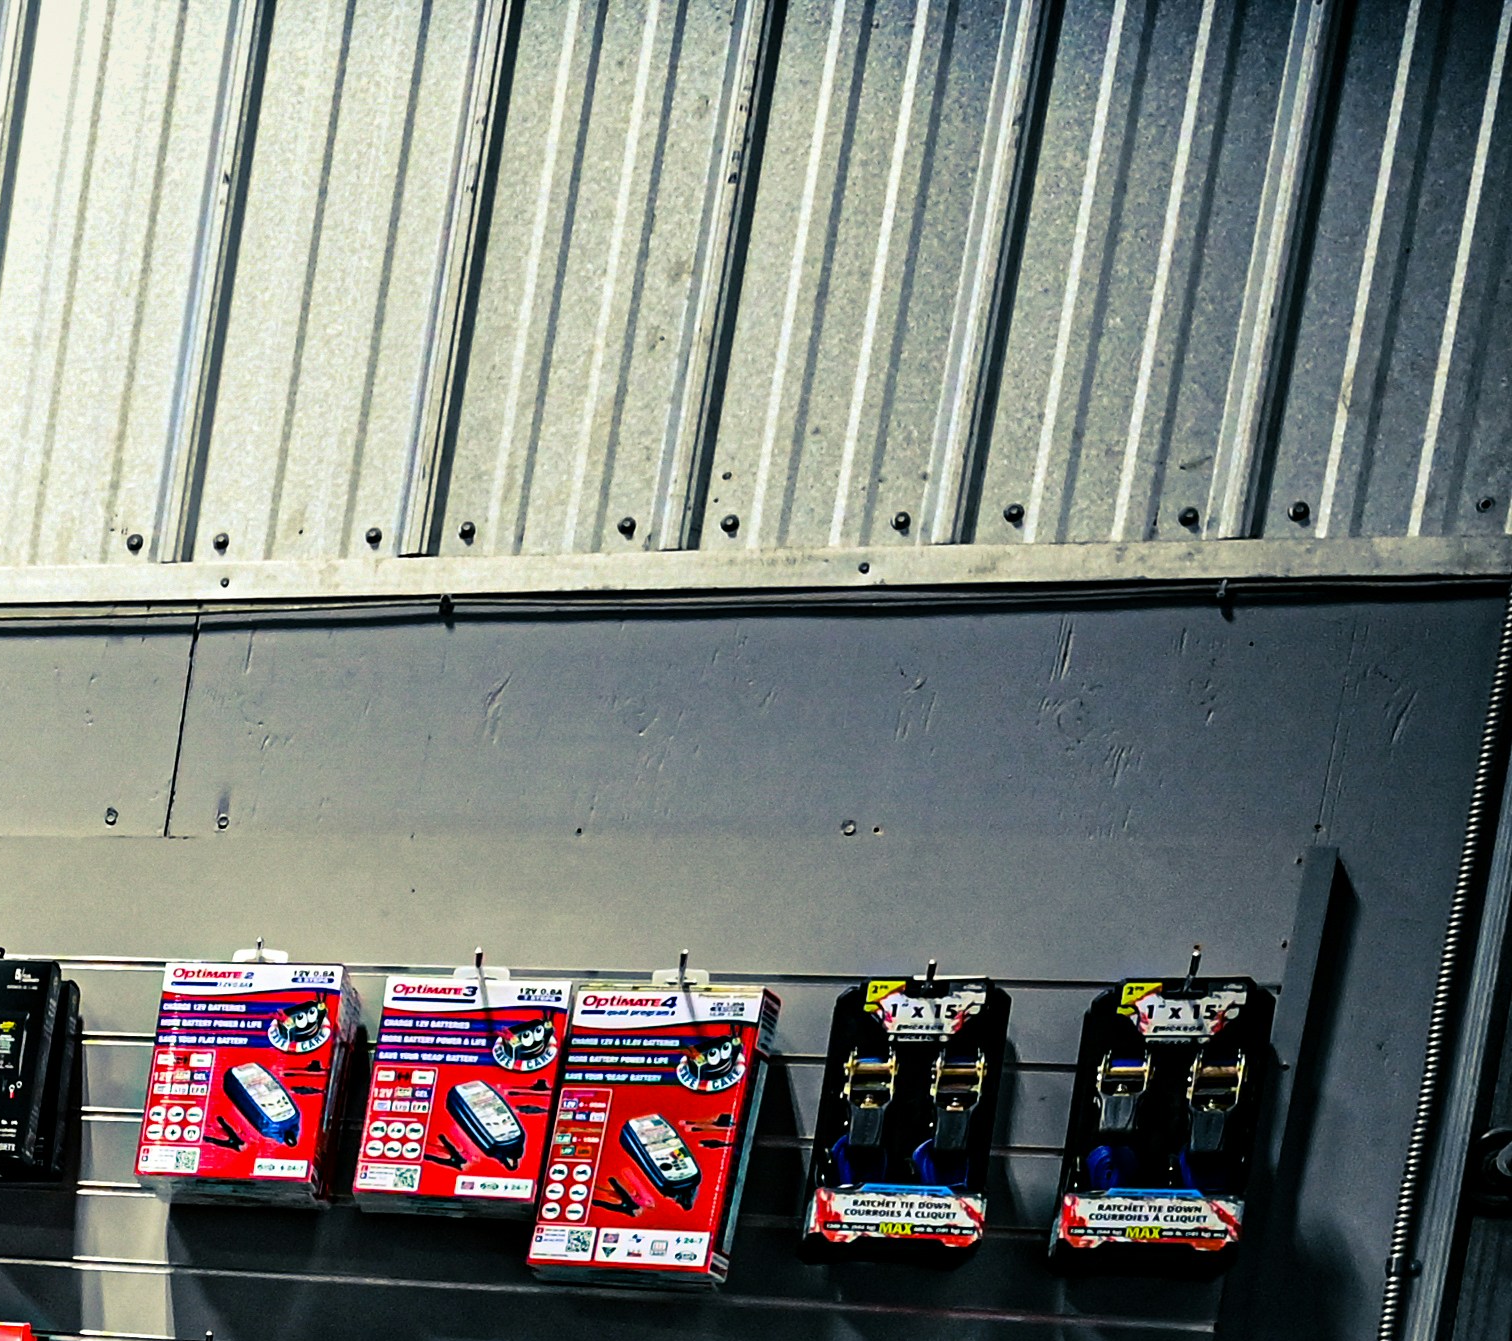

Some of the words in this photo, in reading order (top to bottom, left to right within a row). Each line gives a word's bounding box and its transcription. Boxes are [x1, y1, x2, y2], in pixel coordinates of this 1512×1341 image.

[173, 968, 242, 980] OptiMATE
[393, 983, 463, 996] OptiMATE
[463, 986, 478, 996] 3
[582, 994, 661, 1008] OptiMATE
[661, 996, 678, 1008] 4
[208, 1004, 246, 1012] BATTERIES
[247, 1020, 262, 1028] LIFE
[431, 1021, 469, 1029] BATTERIES
[301, 1031, 326, 1051] CARE
[526, 1051, 555, 1069] CARE
[713, 1070, 741, 1089] CARE
[853, 1200, 896, 1208] RATCHET
[900, 1201, 914, 1209] TIE
[918, 1202, 951, 1210] DOWN
[1098, 1204, 1143, 1212] RATCHET
[1148, 1204, 1163, 1213] TIE
[1167, 1205, 1202, 1213] DOWN
[844, 1209, 901, 1218] COURROIES
[915, 1210, 957, 1219] CLIQUET
[1089, 1213, 1149, 1222] COURROIES
[1164, 1214, 1207, 1223] CLIQUET
[879, 1222, 914, 1235] MAX
[1125, 1226, 1161, 1239] MAX
